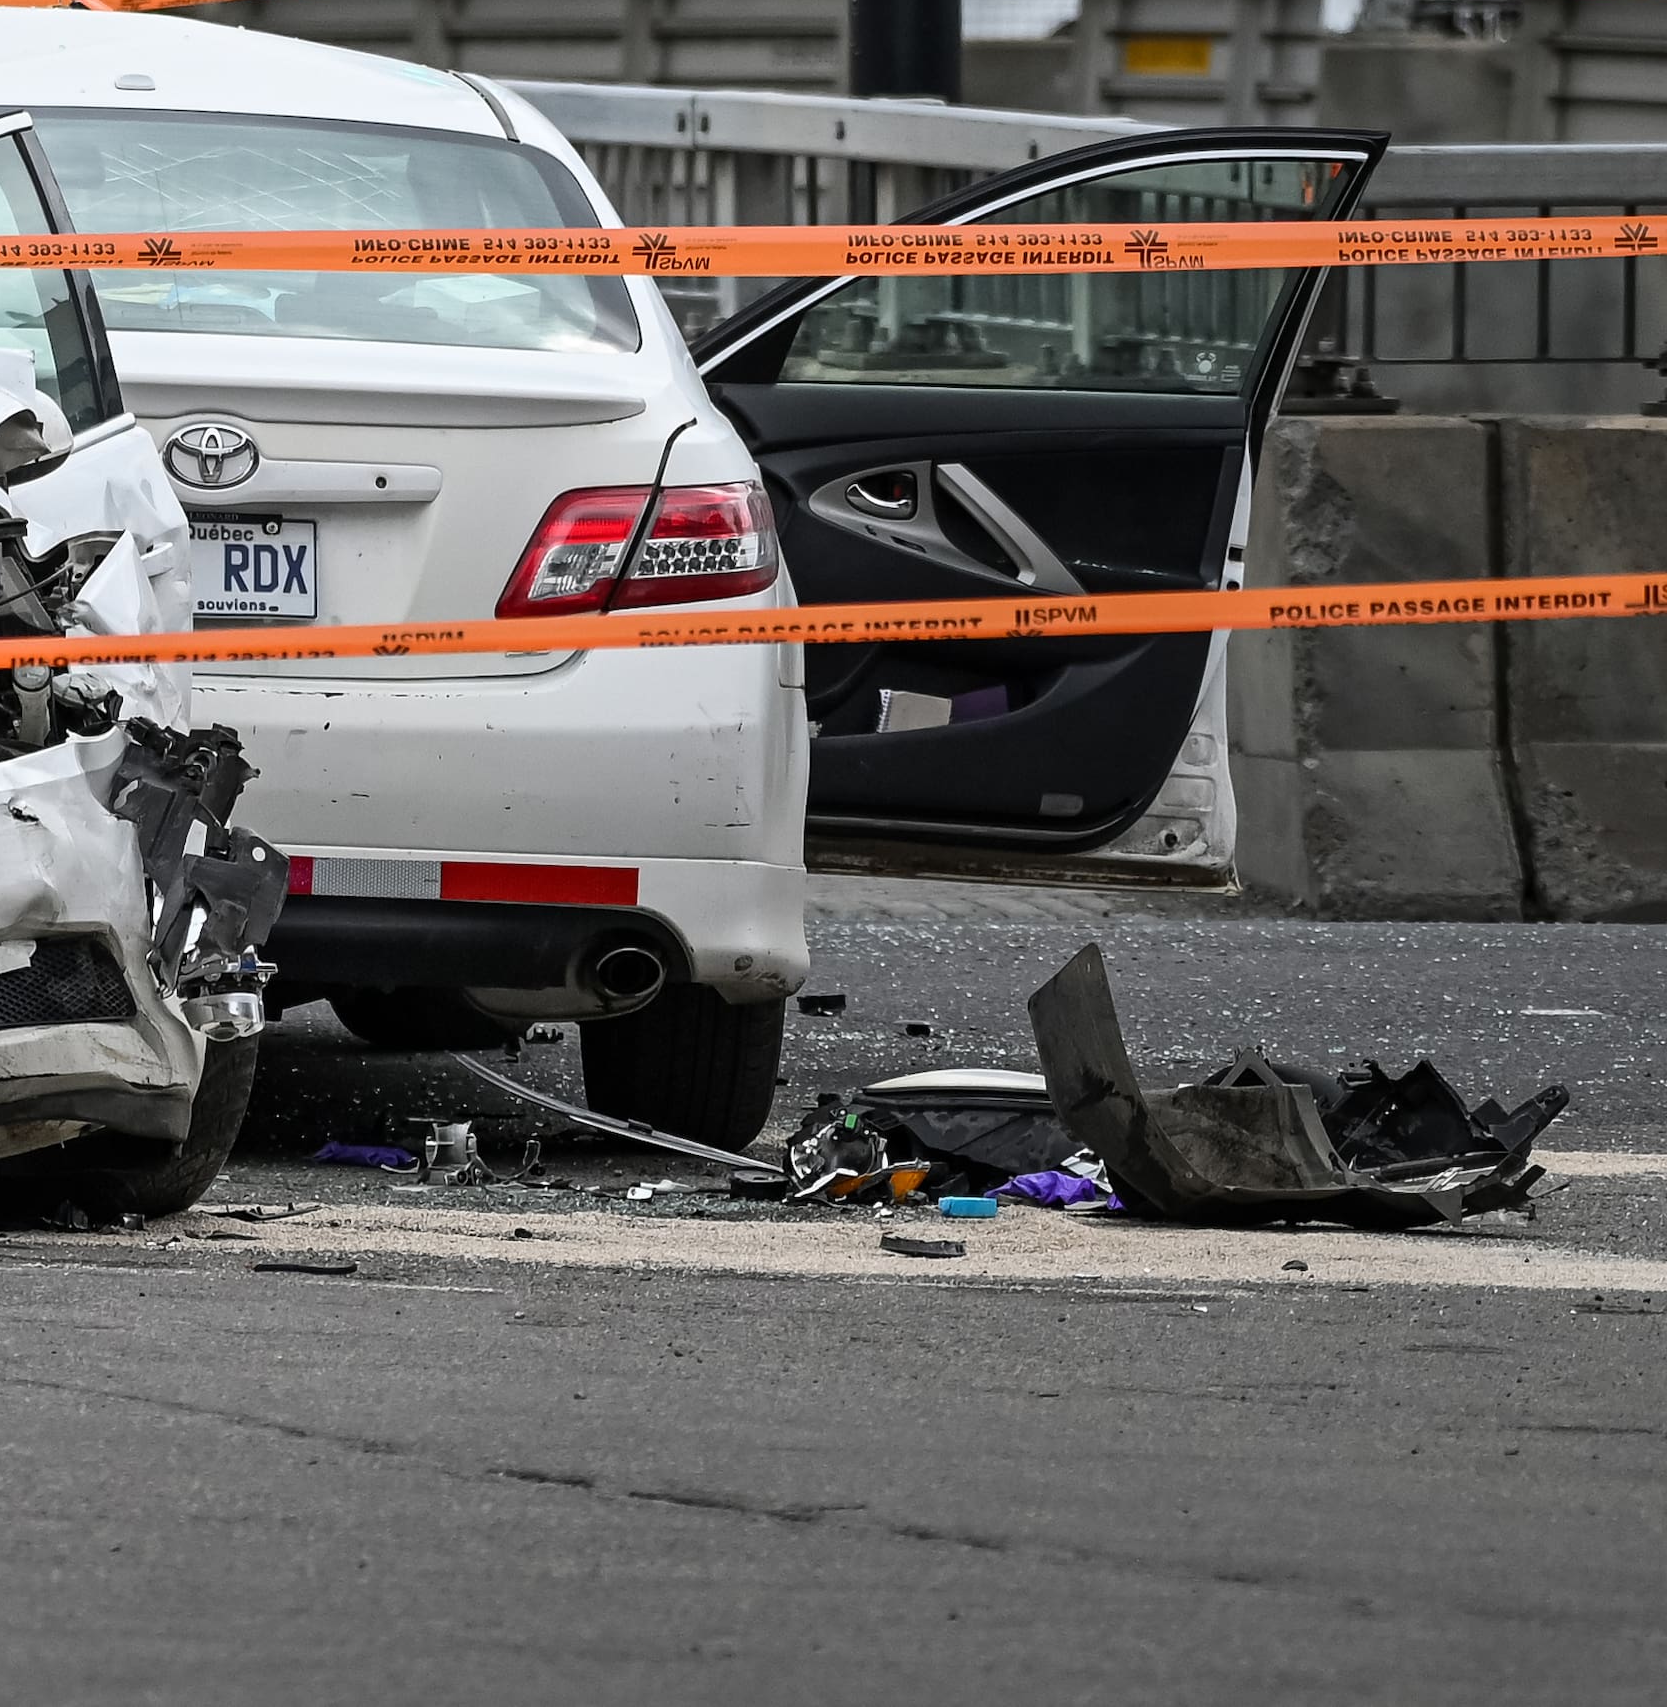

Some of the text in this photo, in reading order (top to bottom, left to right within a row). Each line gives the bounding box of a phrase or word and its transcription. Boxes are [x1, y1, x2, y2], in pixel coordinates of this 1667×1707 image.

[223, 544, 308, 594] RDX
[197, 598, 267, 611] souviens
[1034, 605, 1098, 626] SPVM
[1269, 592, 1613, 622] POLICE PASSAGE INTERDIT
